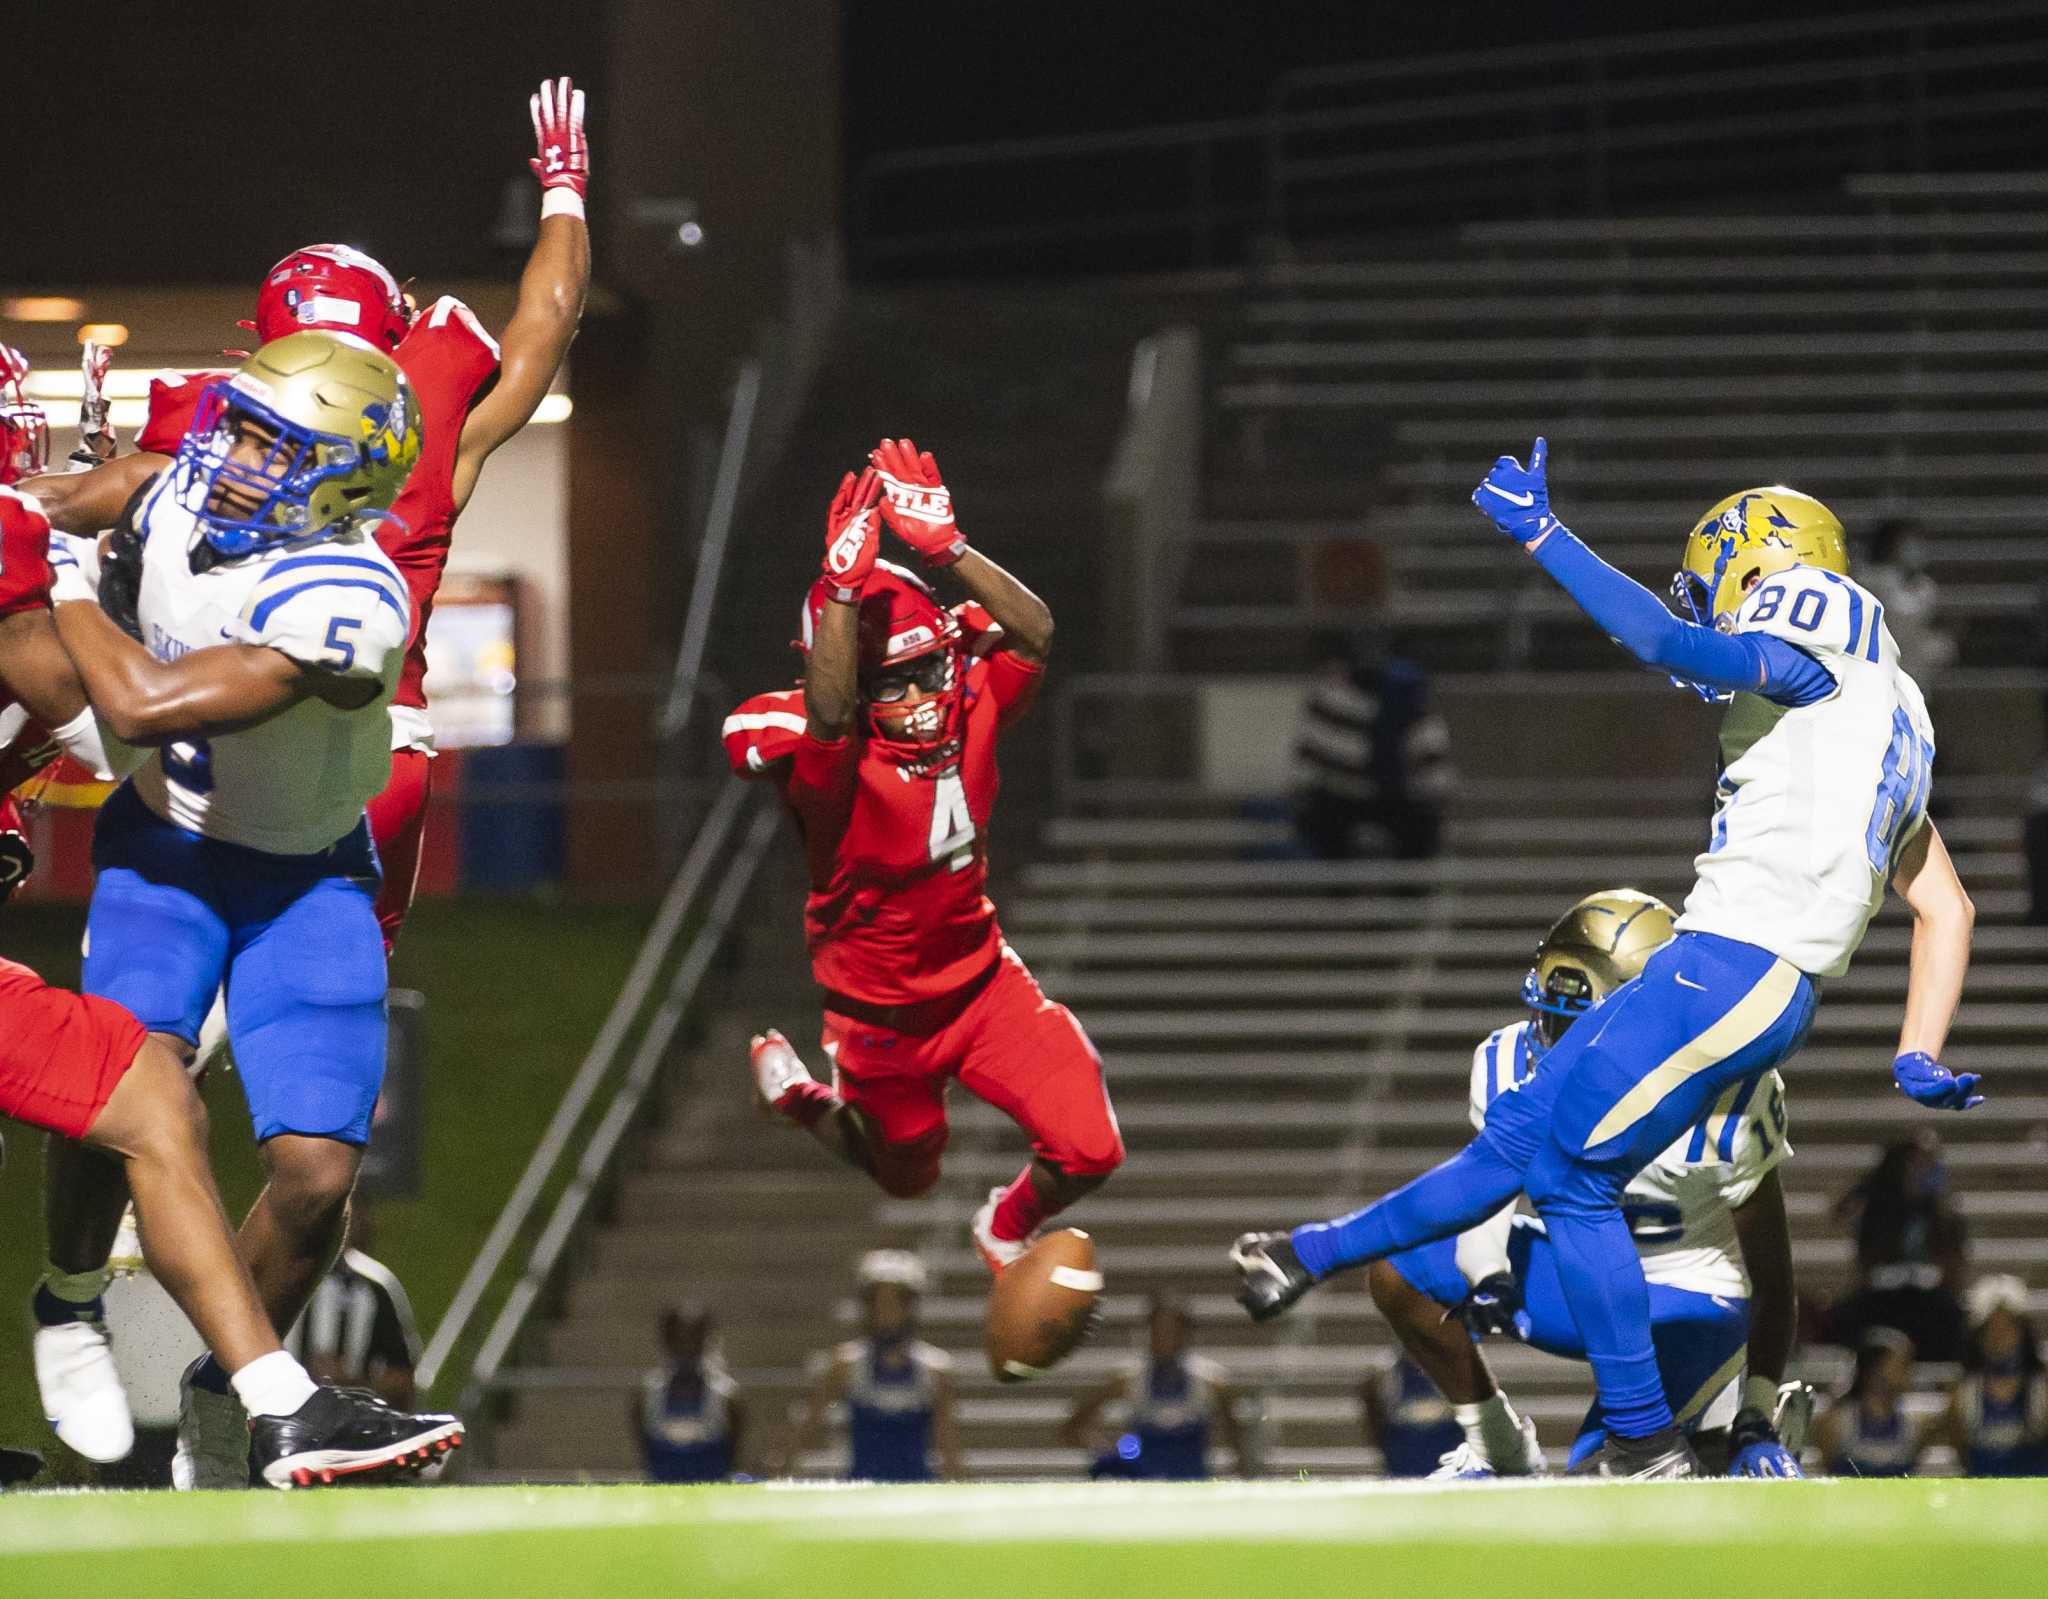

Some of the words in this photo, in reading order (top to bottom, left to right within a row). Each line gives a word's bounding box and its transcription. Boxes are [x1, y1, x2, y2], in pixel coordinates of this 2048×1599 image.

[1749, 586, 1828, 631] 80
[324, 617, 361, 672] 5
[929, 776, 975, 872] 4
